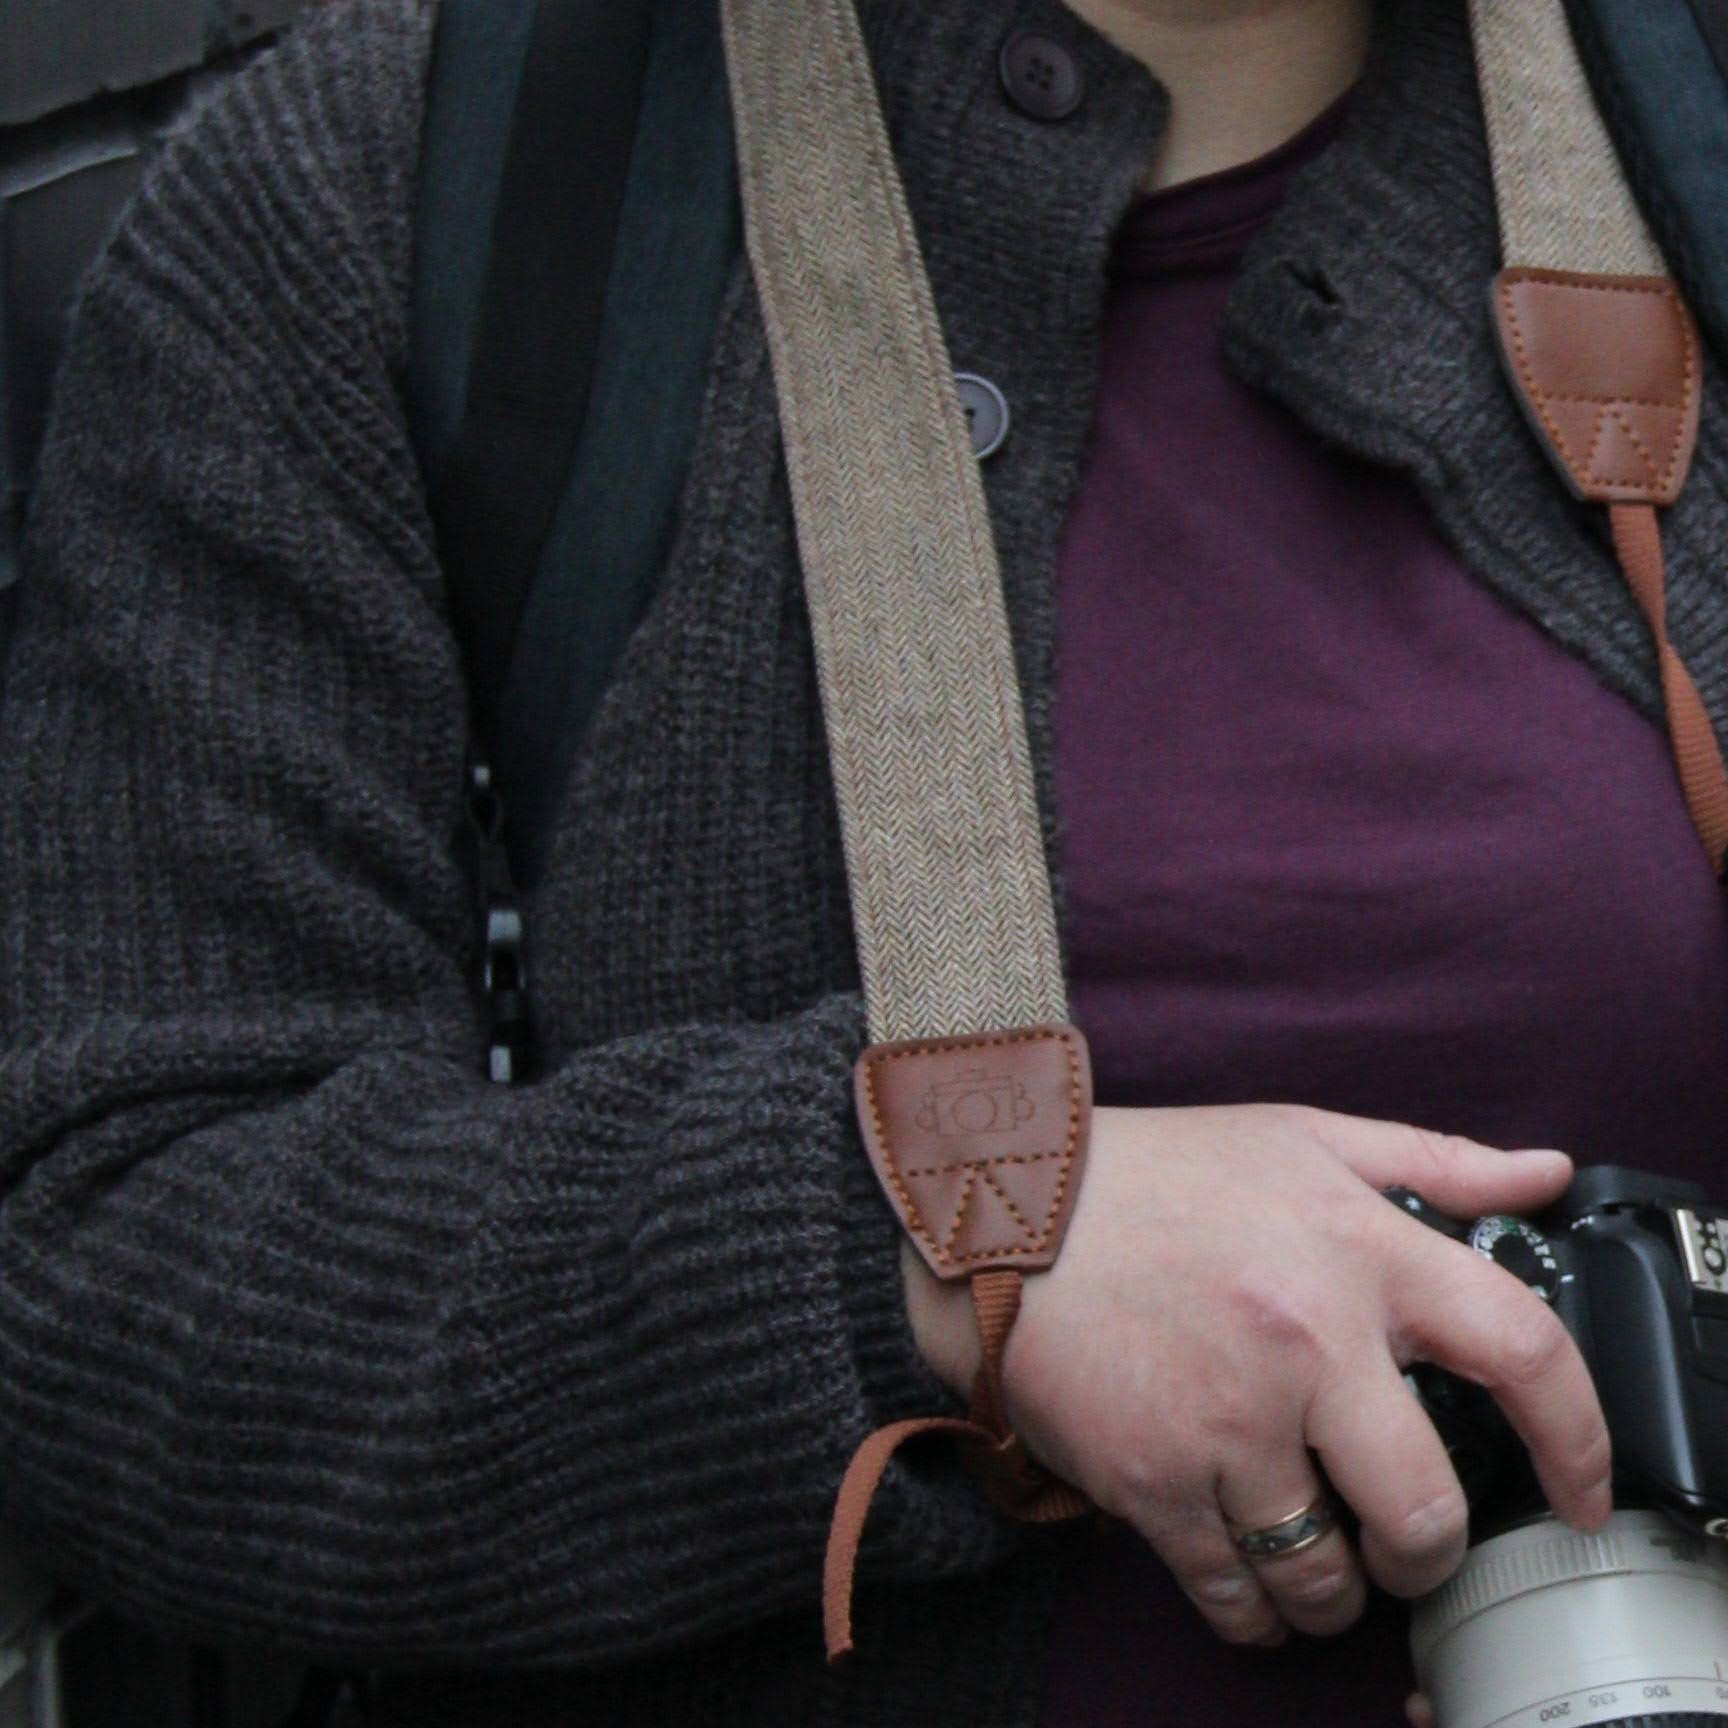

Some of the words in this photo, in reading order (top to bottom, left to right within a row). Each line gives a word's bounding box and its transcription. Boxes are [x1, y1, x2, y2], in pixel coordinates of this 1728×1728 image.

[1641, 1684, 1672, 1698] 100
[1588, 1692, 1619, 1708] 135
[1540, 1702, 1572, 1723] 200
